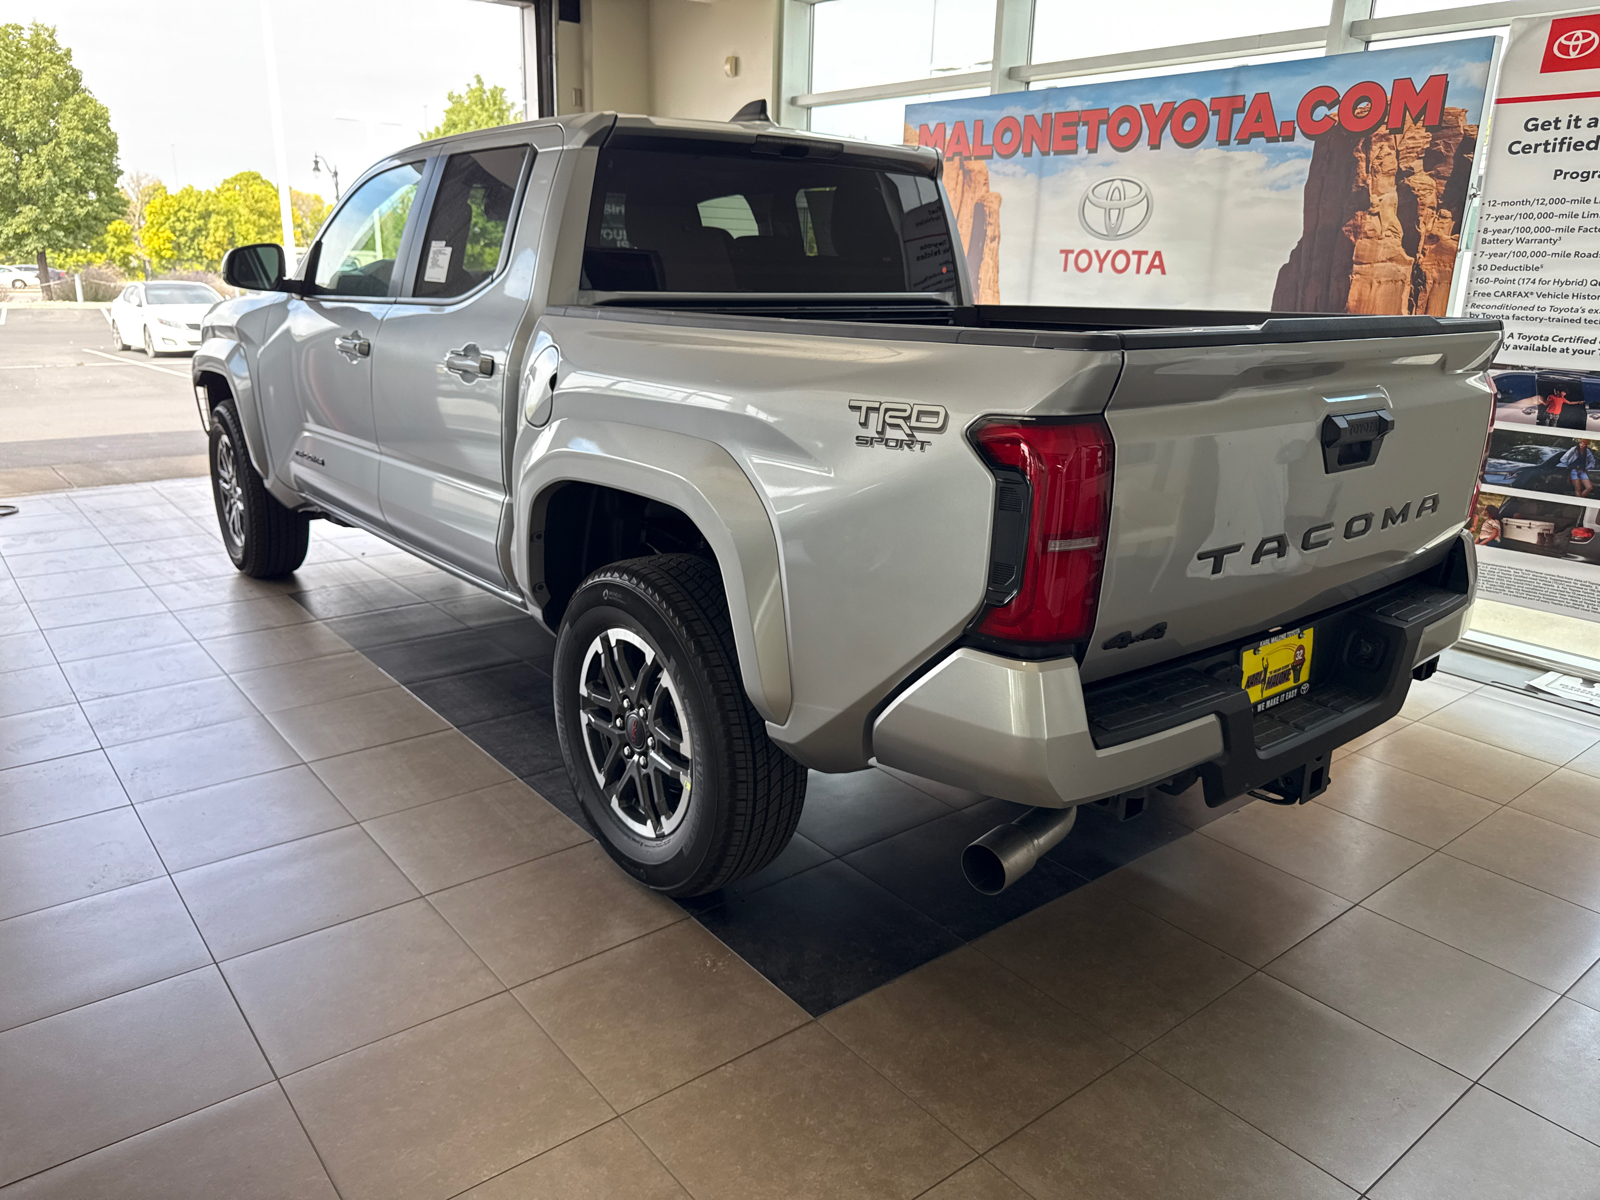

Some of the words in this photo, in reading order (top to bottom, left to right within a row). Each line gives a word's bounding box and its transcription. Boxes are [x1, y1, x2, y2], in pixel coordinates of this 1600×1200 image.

[919, 74, 1449, 161] MALONETOYOTA.COM
[1523, 116, 1562, 132] Get
[1566, 114, 1582, 130] it
[1507, 135, 1600, 155] Certified
[1553, 169, 1600, 182] Progr
[1487, 197, 1592, 207] 12-month/12,000-mile
[1485, 211, 1579, 222] 7-year/100,000-mile
[1581, 211, 1600, 219] Lim
[1482, 226, 1576, 236] 8-year/100,000-mile
[1481, 237, 1514, 246] Battery
[1059, 248, 1167, 275] TOYOTA
[1479, 250, 1572, 260] 7-year/100,000-mile
[1574, 250, 1600, 259] Road
[1477, 264, 1488, 272] $0
[1475, 277, 1516, 285] 160-Point
[1517, 278, 1536, 286] (174
[1537, 278, 1551, 286] for
[1552, 278, 1588, 288] Hybrid)
[1472, 290, 1492, 298] Free
[1536, 291, 1570, 300] Vehicle
[1470, 303, 1535, 312] Reconditioned
[1481, 312, 1510, 321] Toyota
[1511, 313, 1582, 324] factory-trained
[1507, 332, 1515, 340] A
[1517, 332, 1550, 342] Toyota
[1551, 335, 1598, 345] Certified
[1512, 343, 1557, 353] available
[1559, 346, 1570, 354] at
[1571, 347, 1596, 357] your
[848, 399, 950, 441] TRD
[1349, 420, 1378, 436] TOYOTA
[855, 435, 932, 453] SPORT
[1197, 493, 1440, 579] TACOMA
[1295, 650, 1304, 660] 32
[1257, 702, 1265, 712] WE
[1266, 695, 1280, 709] MAKE
[1280, 693, 1285, 702] IT
[1286, 689, 1298, 700] EASY
